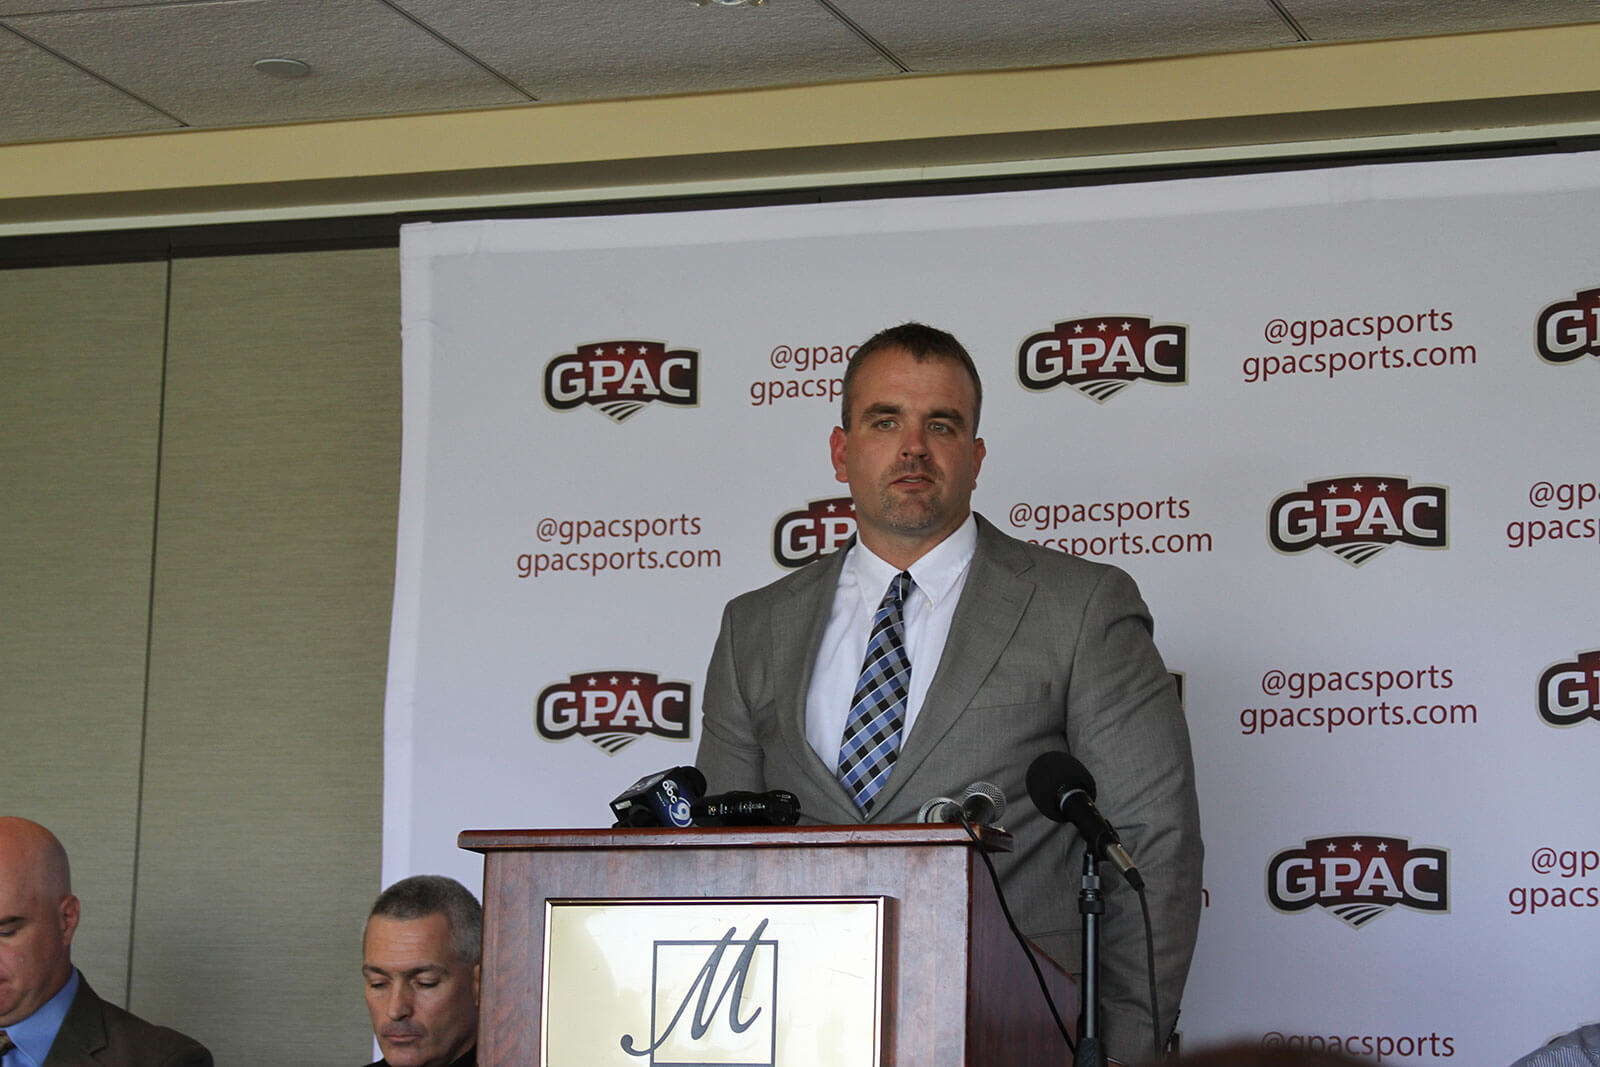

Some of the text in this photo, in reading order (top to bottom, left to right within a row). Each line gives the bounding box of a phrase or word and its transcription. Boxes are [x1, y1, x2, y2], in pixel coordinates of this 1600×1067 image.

[1264, 308, 1453, 347] @gpacsports
[1025, 333, 1178, 382] GPAC
[1243, 345, 1477, 383] gpacsports.com
[551, 358, 691, 402] GPAC
[1009, 496, 1190, 530] @gpacsports
[1529, 481, 1600, 510] @gp
[536, 514, 701, 544] @gpacsports
[1277, 495, 1438, 544] GPAC
[1507, 518, 1600, 548] gpacs
[517, 547, 721, 578] gpacsports.com
[1262, 665, 1453, 699] @gpacsports
[1547, 670, 1600, 716] G
[543, 689, 684, 732] GPAC
[1240, 702, 1477, 735] gpacsports.com
[662, 780, 678, 804] abc
[1275, 856, 1439, 902] GPAC
